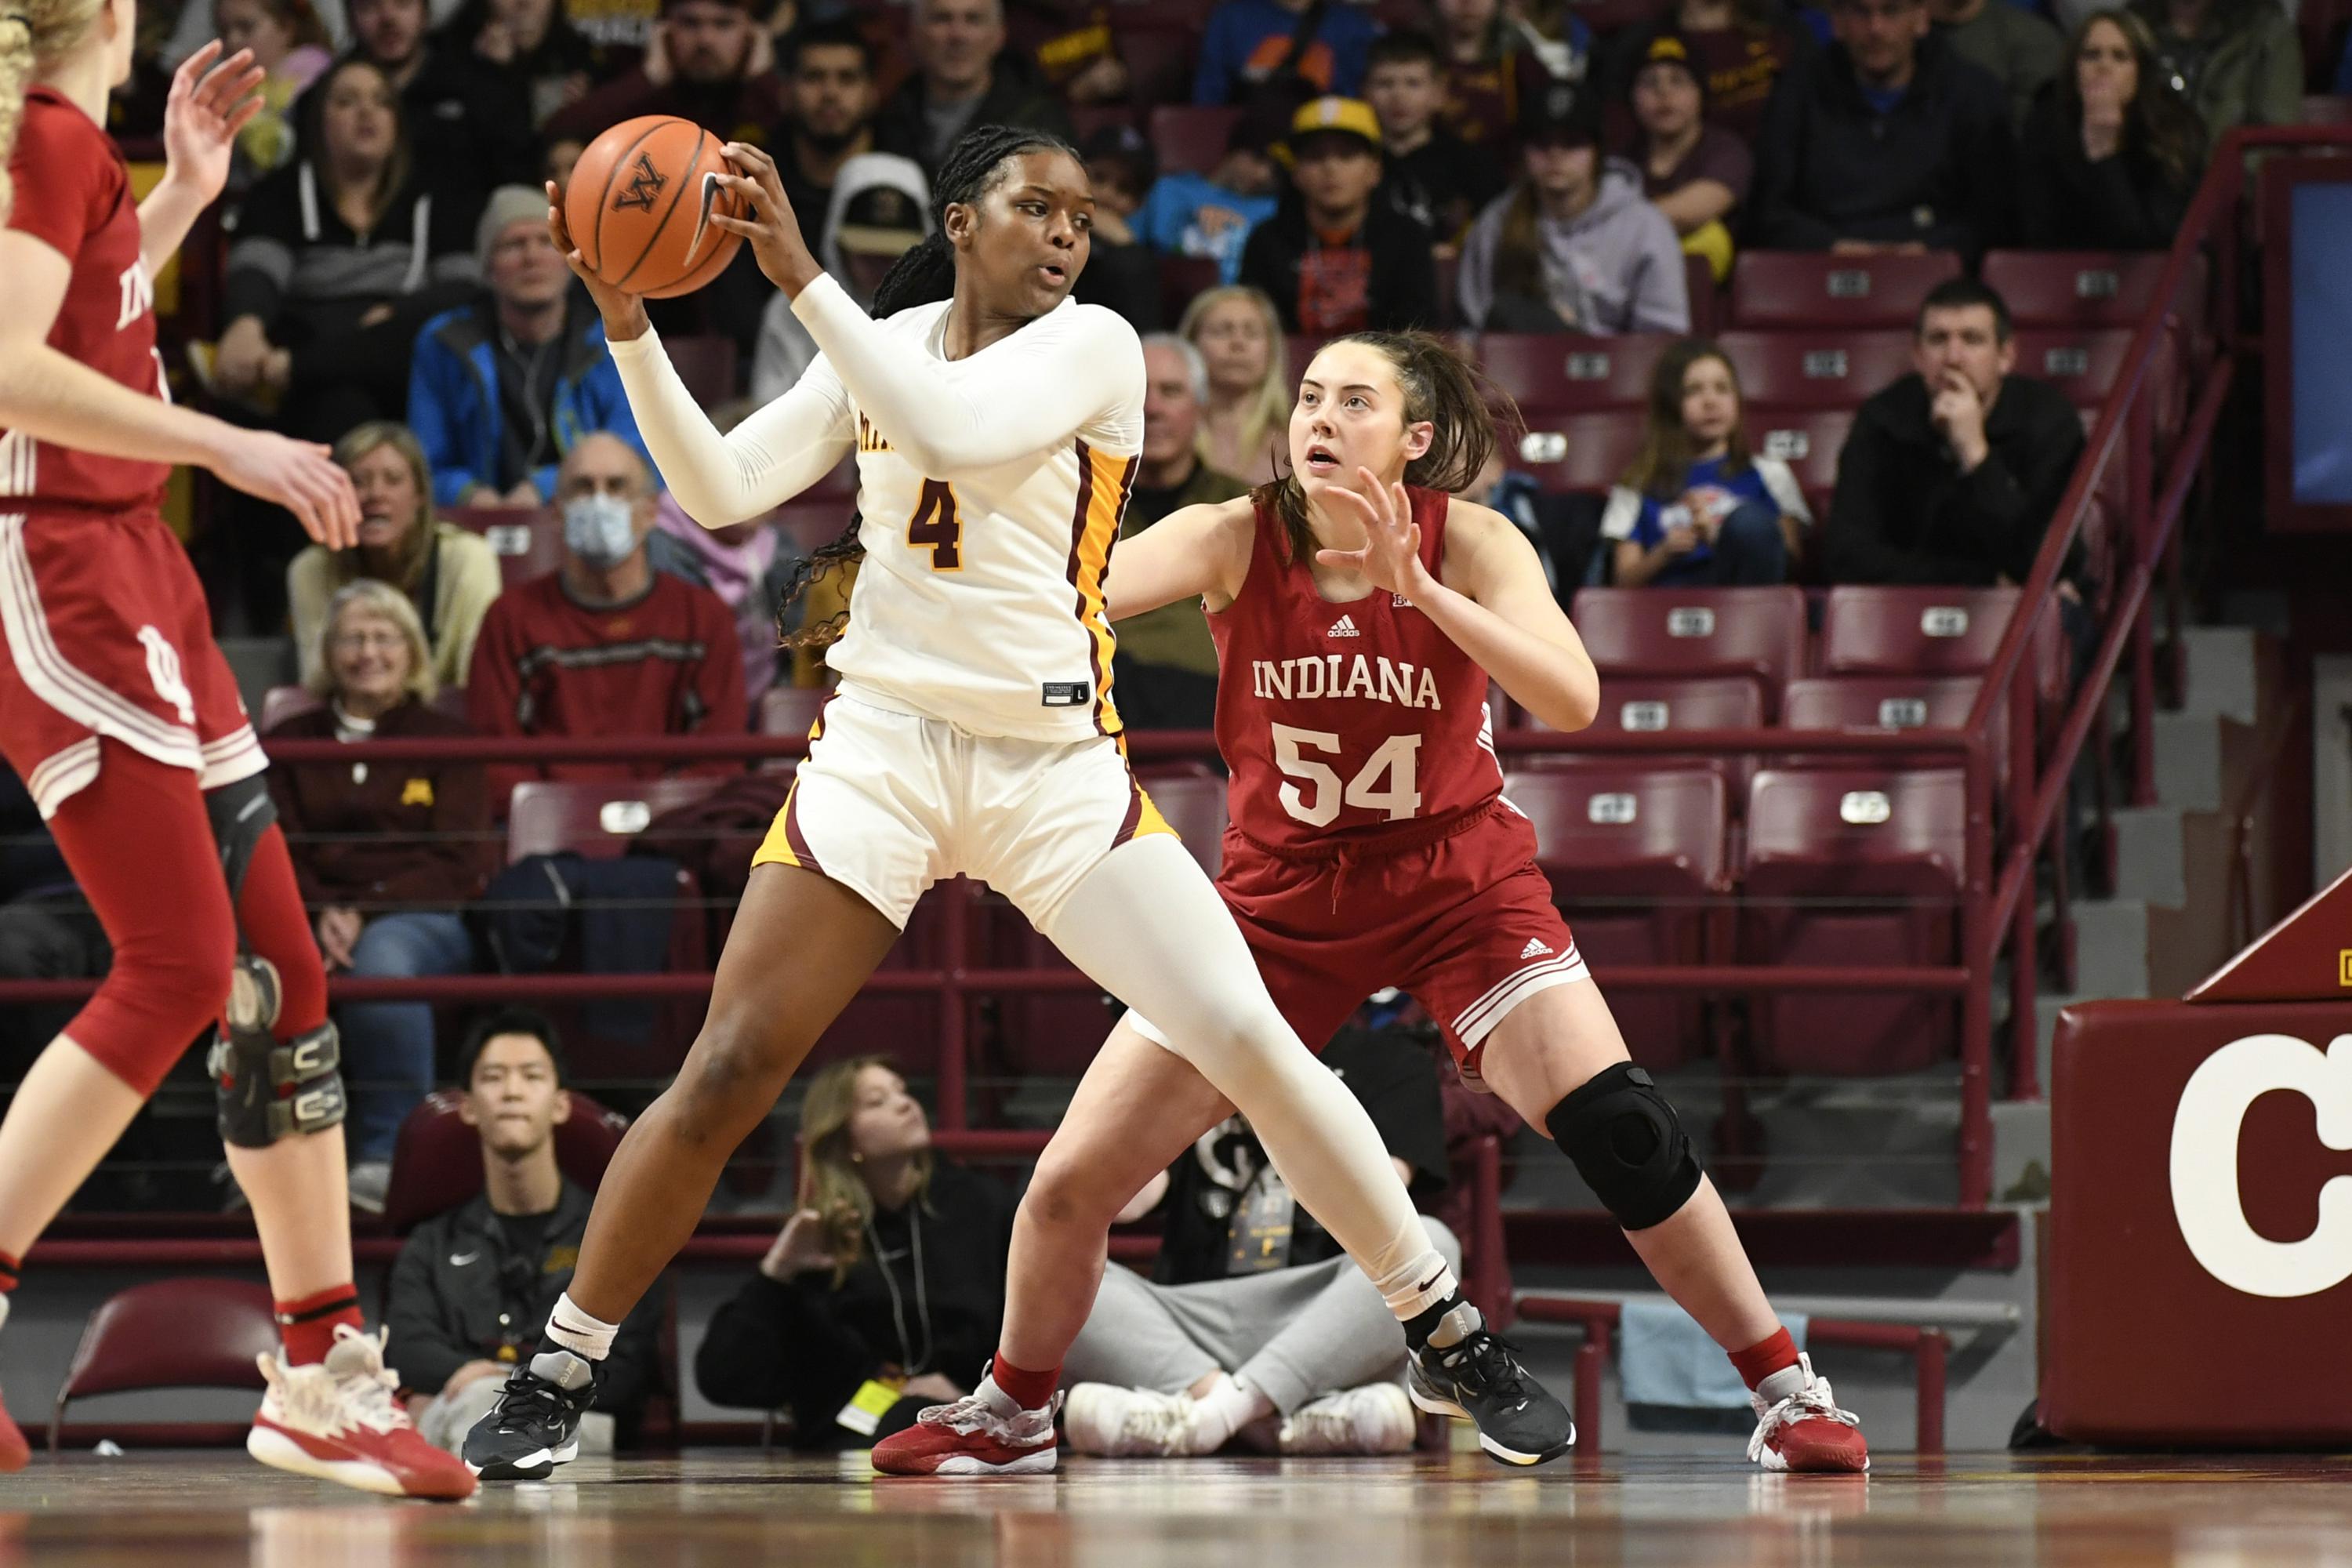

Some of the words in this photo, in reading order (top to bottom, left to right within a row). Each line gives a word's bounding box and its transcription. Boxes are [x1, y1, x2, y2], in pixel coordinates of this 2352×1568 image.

[906, 476, 964, 572] 4
[1327, 626, 1360, 637] adidas
[1252, 654, 1442, 710] INDIANA
[1270, 720, 1422, 828] 54
[1520, 946, 1554, 960] adidas
